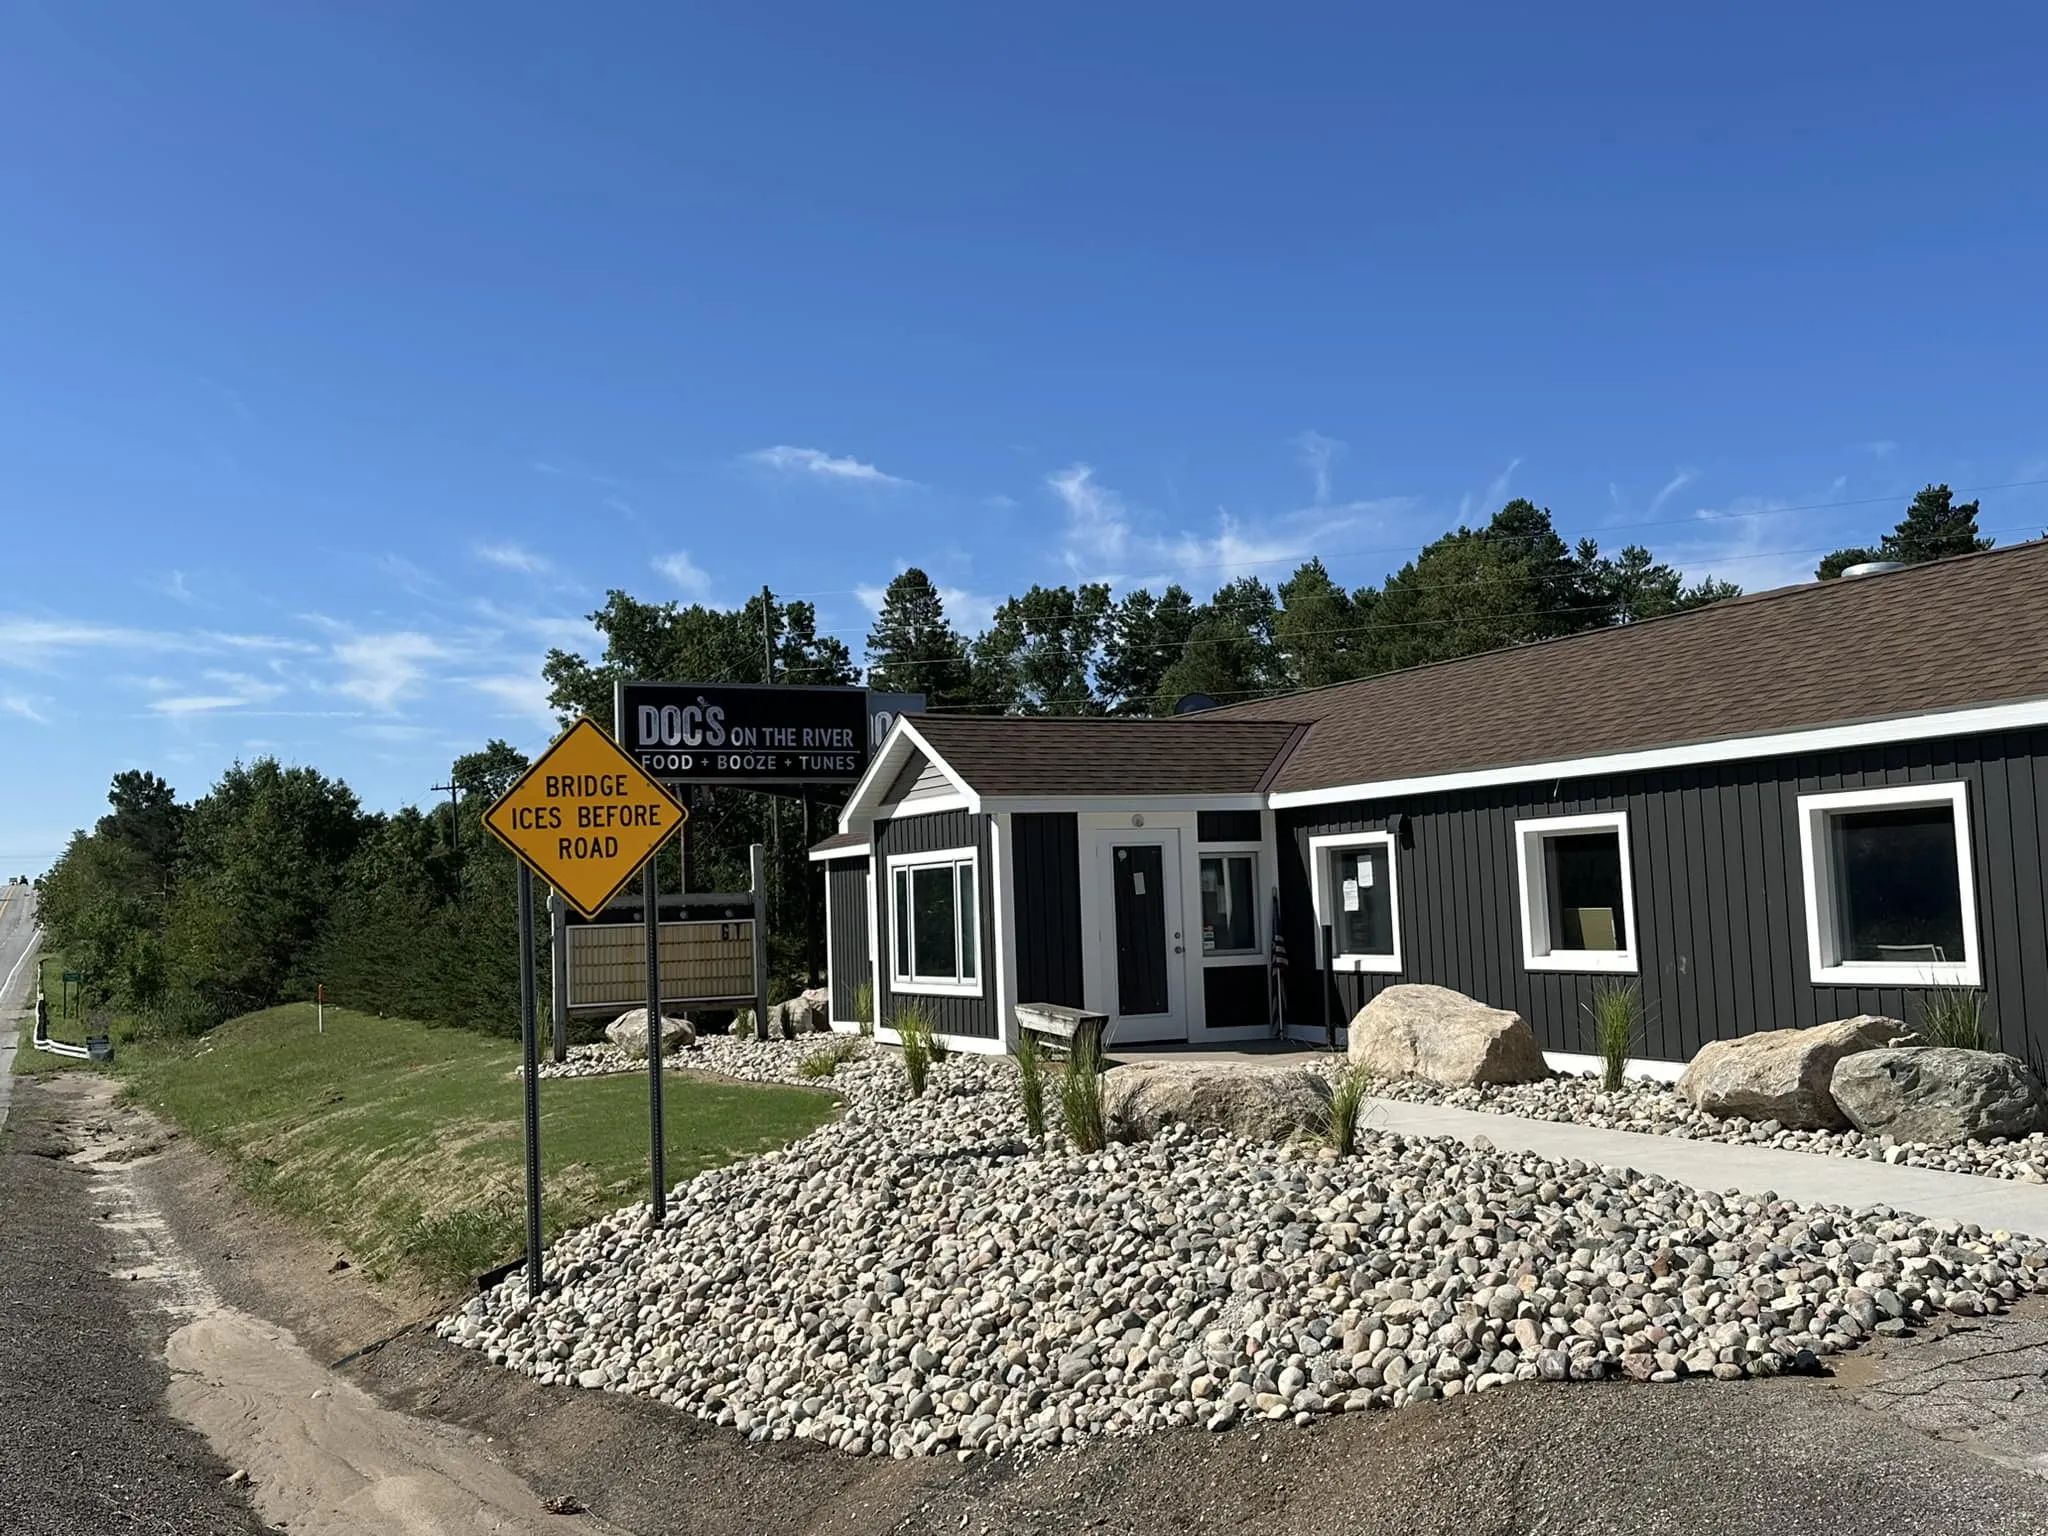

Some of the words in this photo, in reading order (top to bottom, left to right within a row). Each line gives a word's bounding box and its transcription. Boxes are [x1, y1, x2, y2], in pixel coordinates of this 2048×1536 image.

[731, 727, 757, 746] ON
[762, 728, 797, 747] THE
[803, 728, 854, 747] RIVER
[641, 755, 693, 770] FOOD
[717, 755, 777, 770] BOOZE
[799, 756, 855, 771] TUNES
[546, 774, 628, 798] BRIDGE
[512, 807, 562, 830] ICES
[578, 804, 661, 828] BEFORE
[559, 836, 618, 860] ROAD
